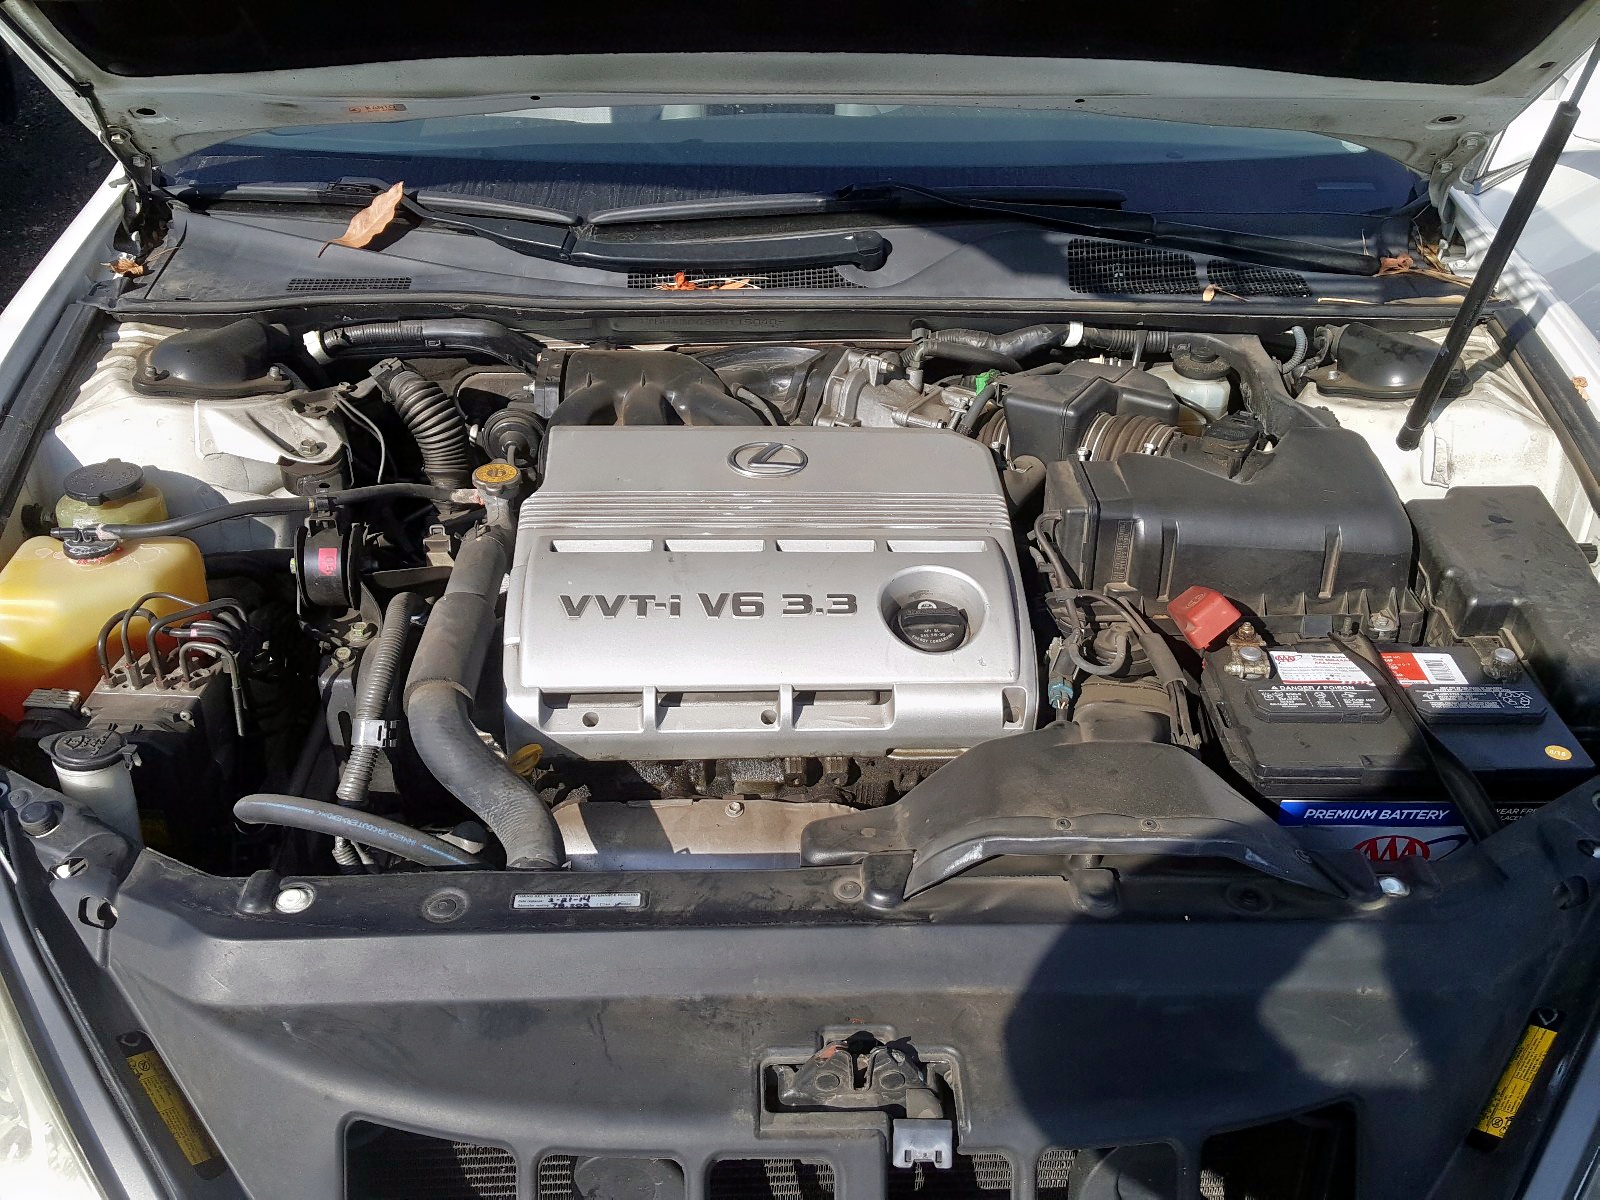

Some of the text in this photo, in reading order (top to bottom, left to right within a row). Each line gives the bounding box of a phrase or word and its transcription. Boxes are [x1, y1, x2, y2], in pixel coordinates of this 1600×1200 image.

[559, 591, 858, 619] VVT-i V6 3.3
[1303, 808, 1451, 820] PREMIUM BATTERY
